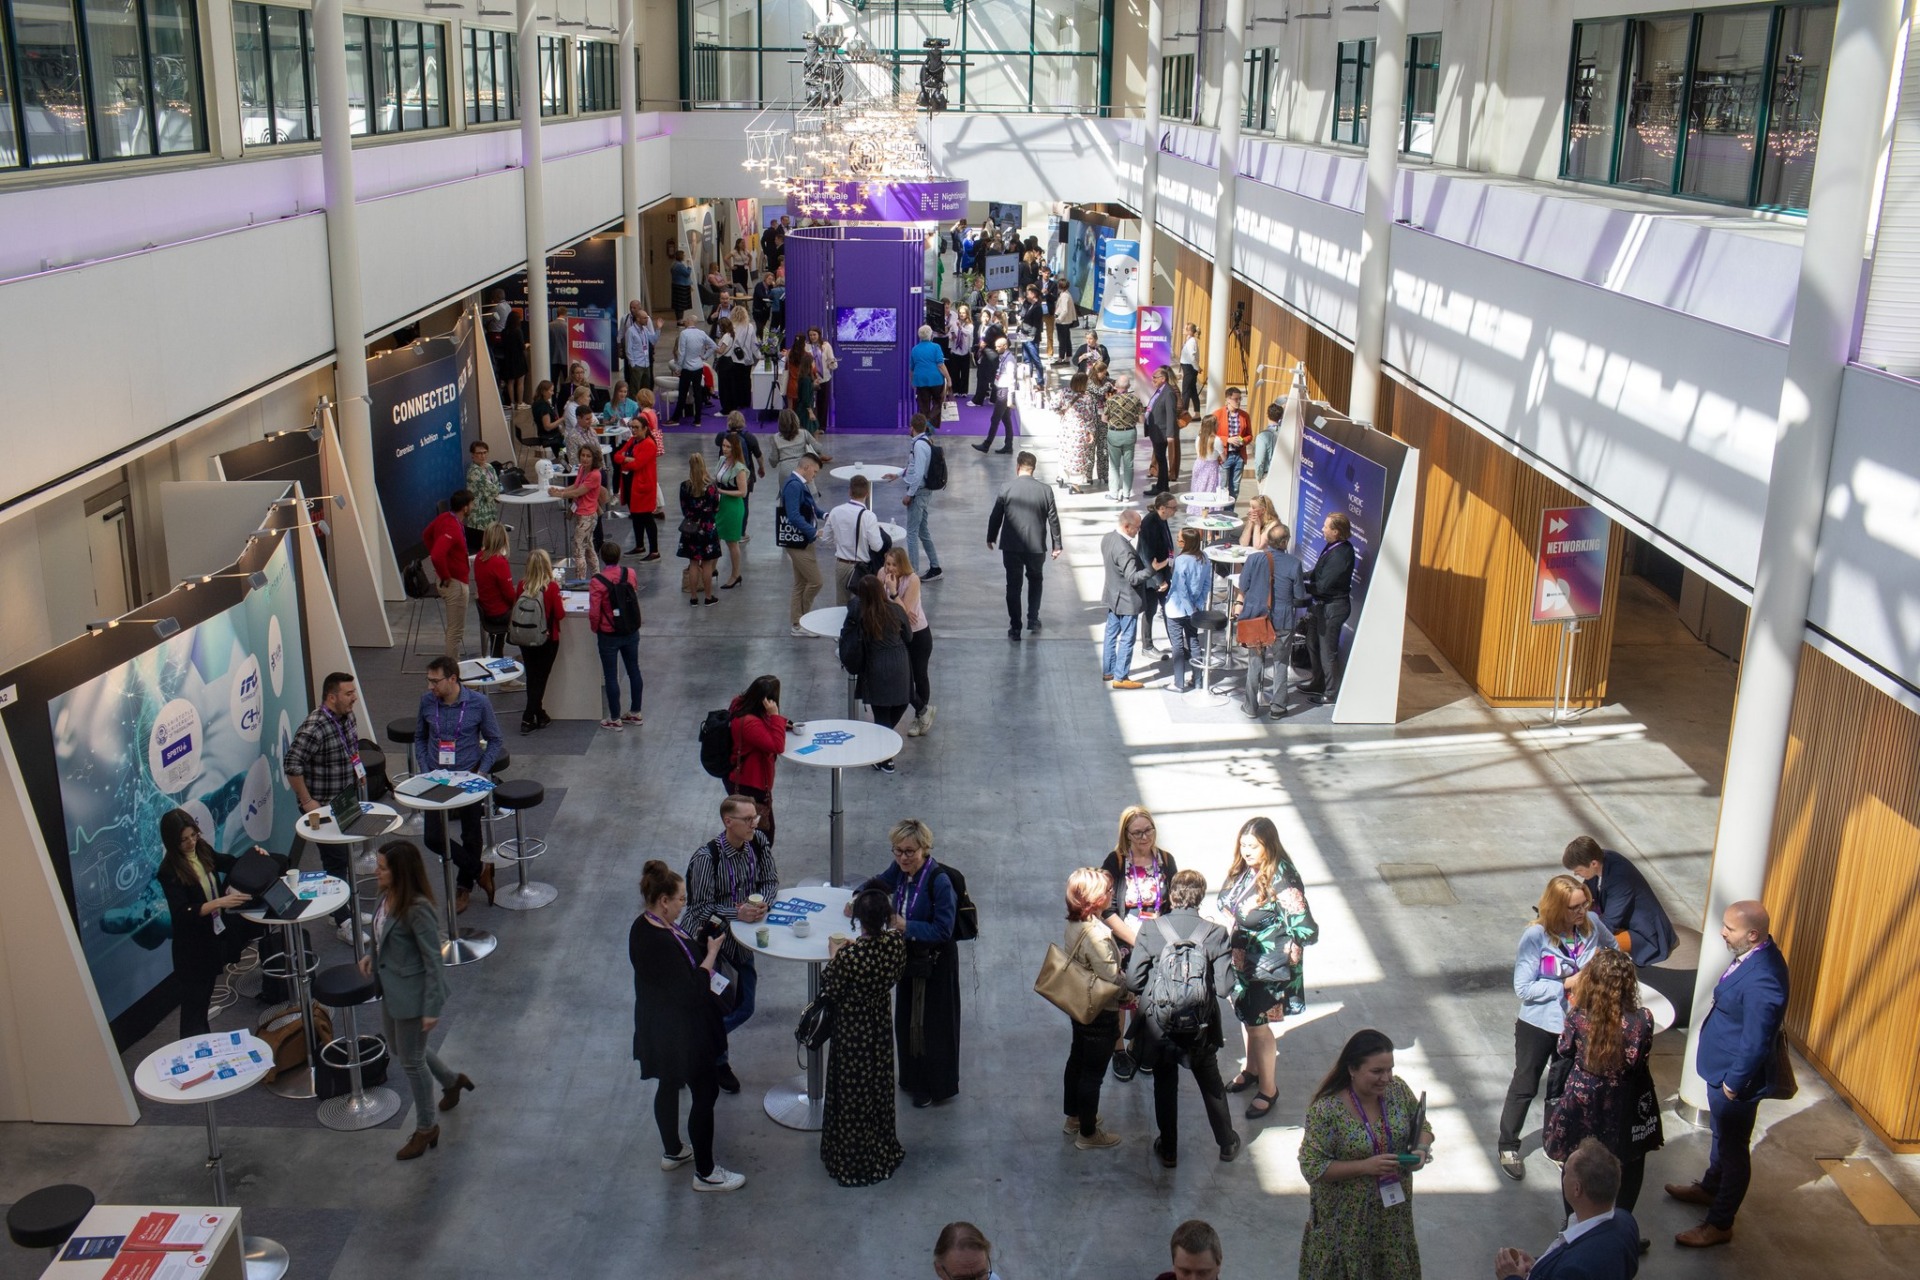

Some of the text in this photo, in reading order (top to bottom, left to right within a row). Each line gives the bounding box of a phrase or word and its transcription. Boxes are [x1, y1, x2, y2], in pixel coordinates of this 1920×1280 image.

[941, 202, 960, 210] Health
[572, 340, 606, 350] RESTAURANT
[392, 382, 456, 425] CONNECTED
[1348, 493, 1364, 508] NORDIC
[780, 515, 791, 525] W
[779, 524, 802, 533] LOV
[1546, 538, 1601, 554] NETWORKING
[1545, 555, 1578, 570] LOUNGE
